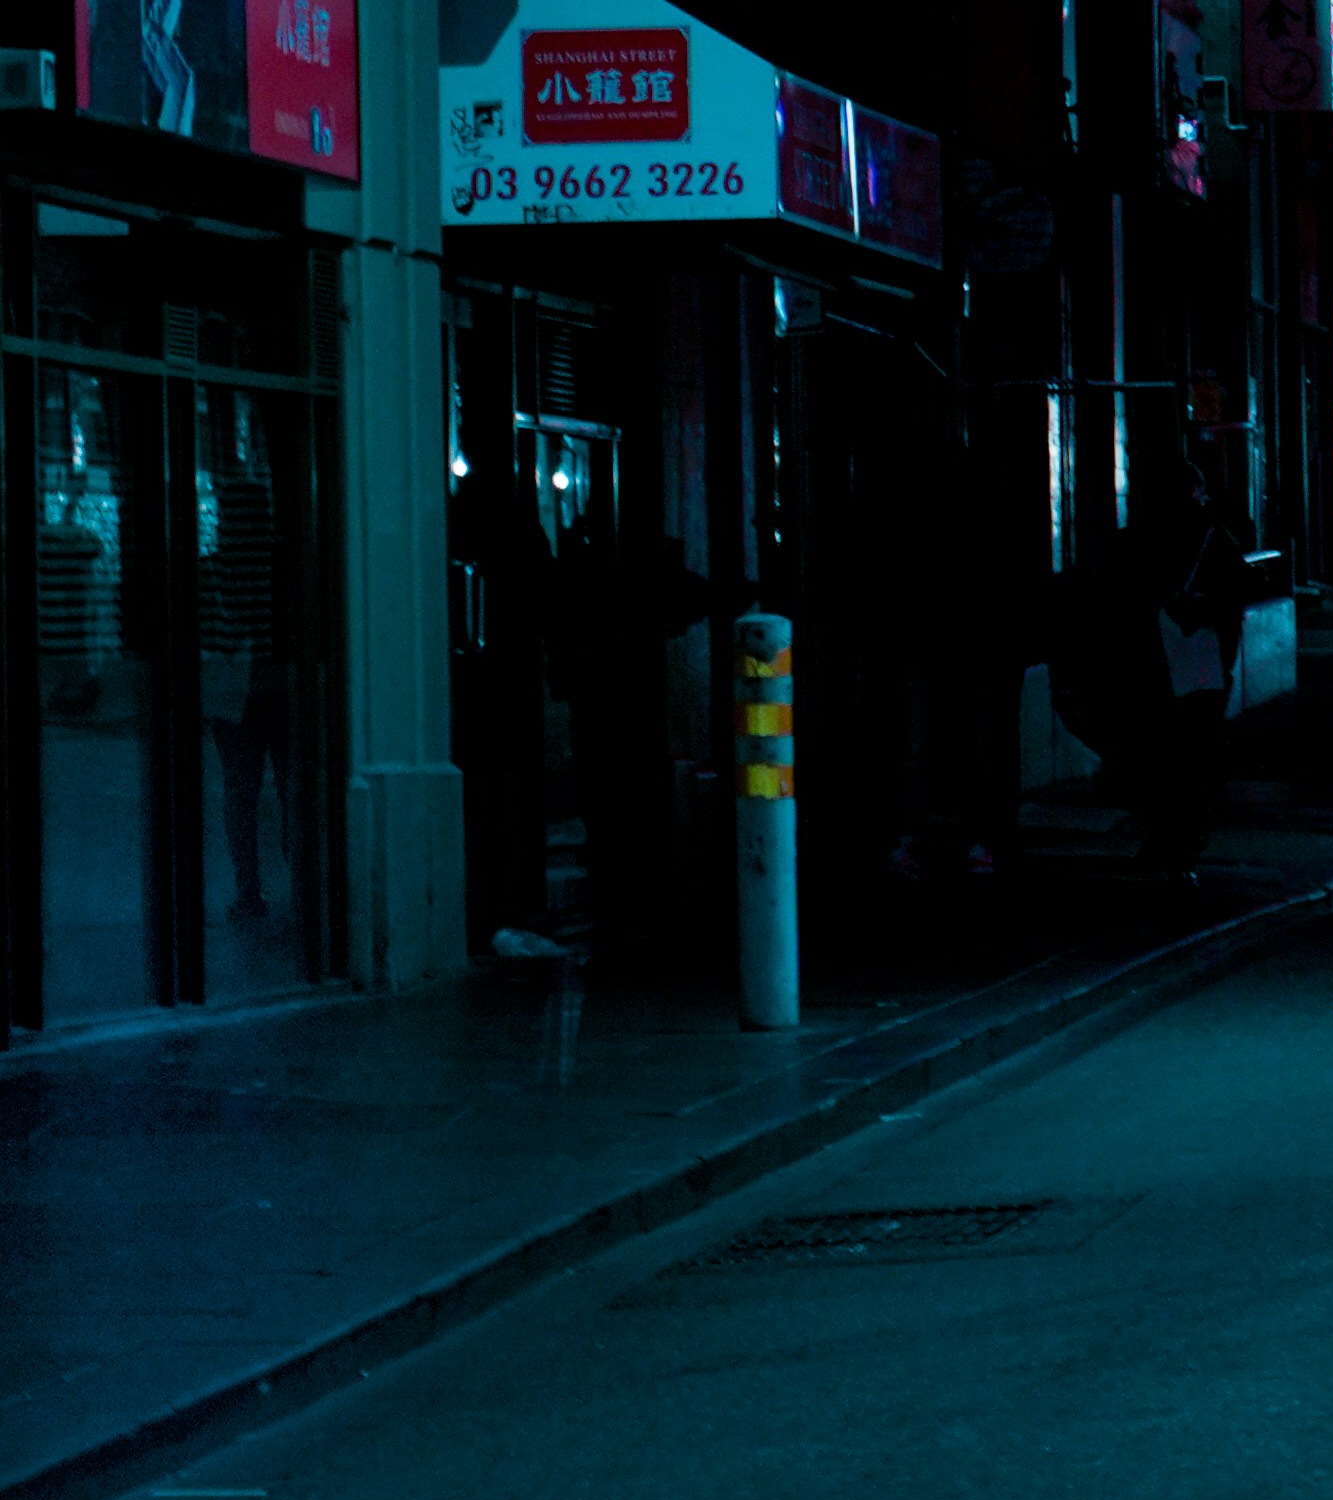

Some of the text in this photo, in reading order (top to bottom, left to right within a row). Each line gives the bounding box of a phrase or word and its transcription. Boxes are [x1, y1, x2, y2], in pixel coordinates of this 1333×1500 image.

[533, 48, 677, 65] SHANGHAI STREET
[471, 163, 745, 200] 03 9662 3226
